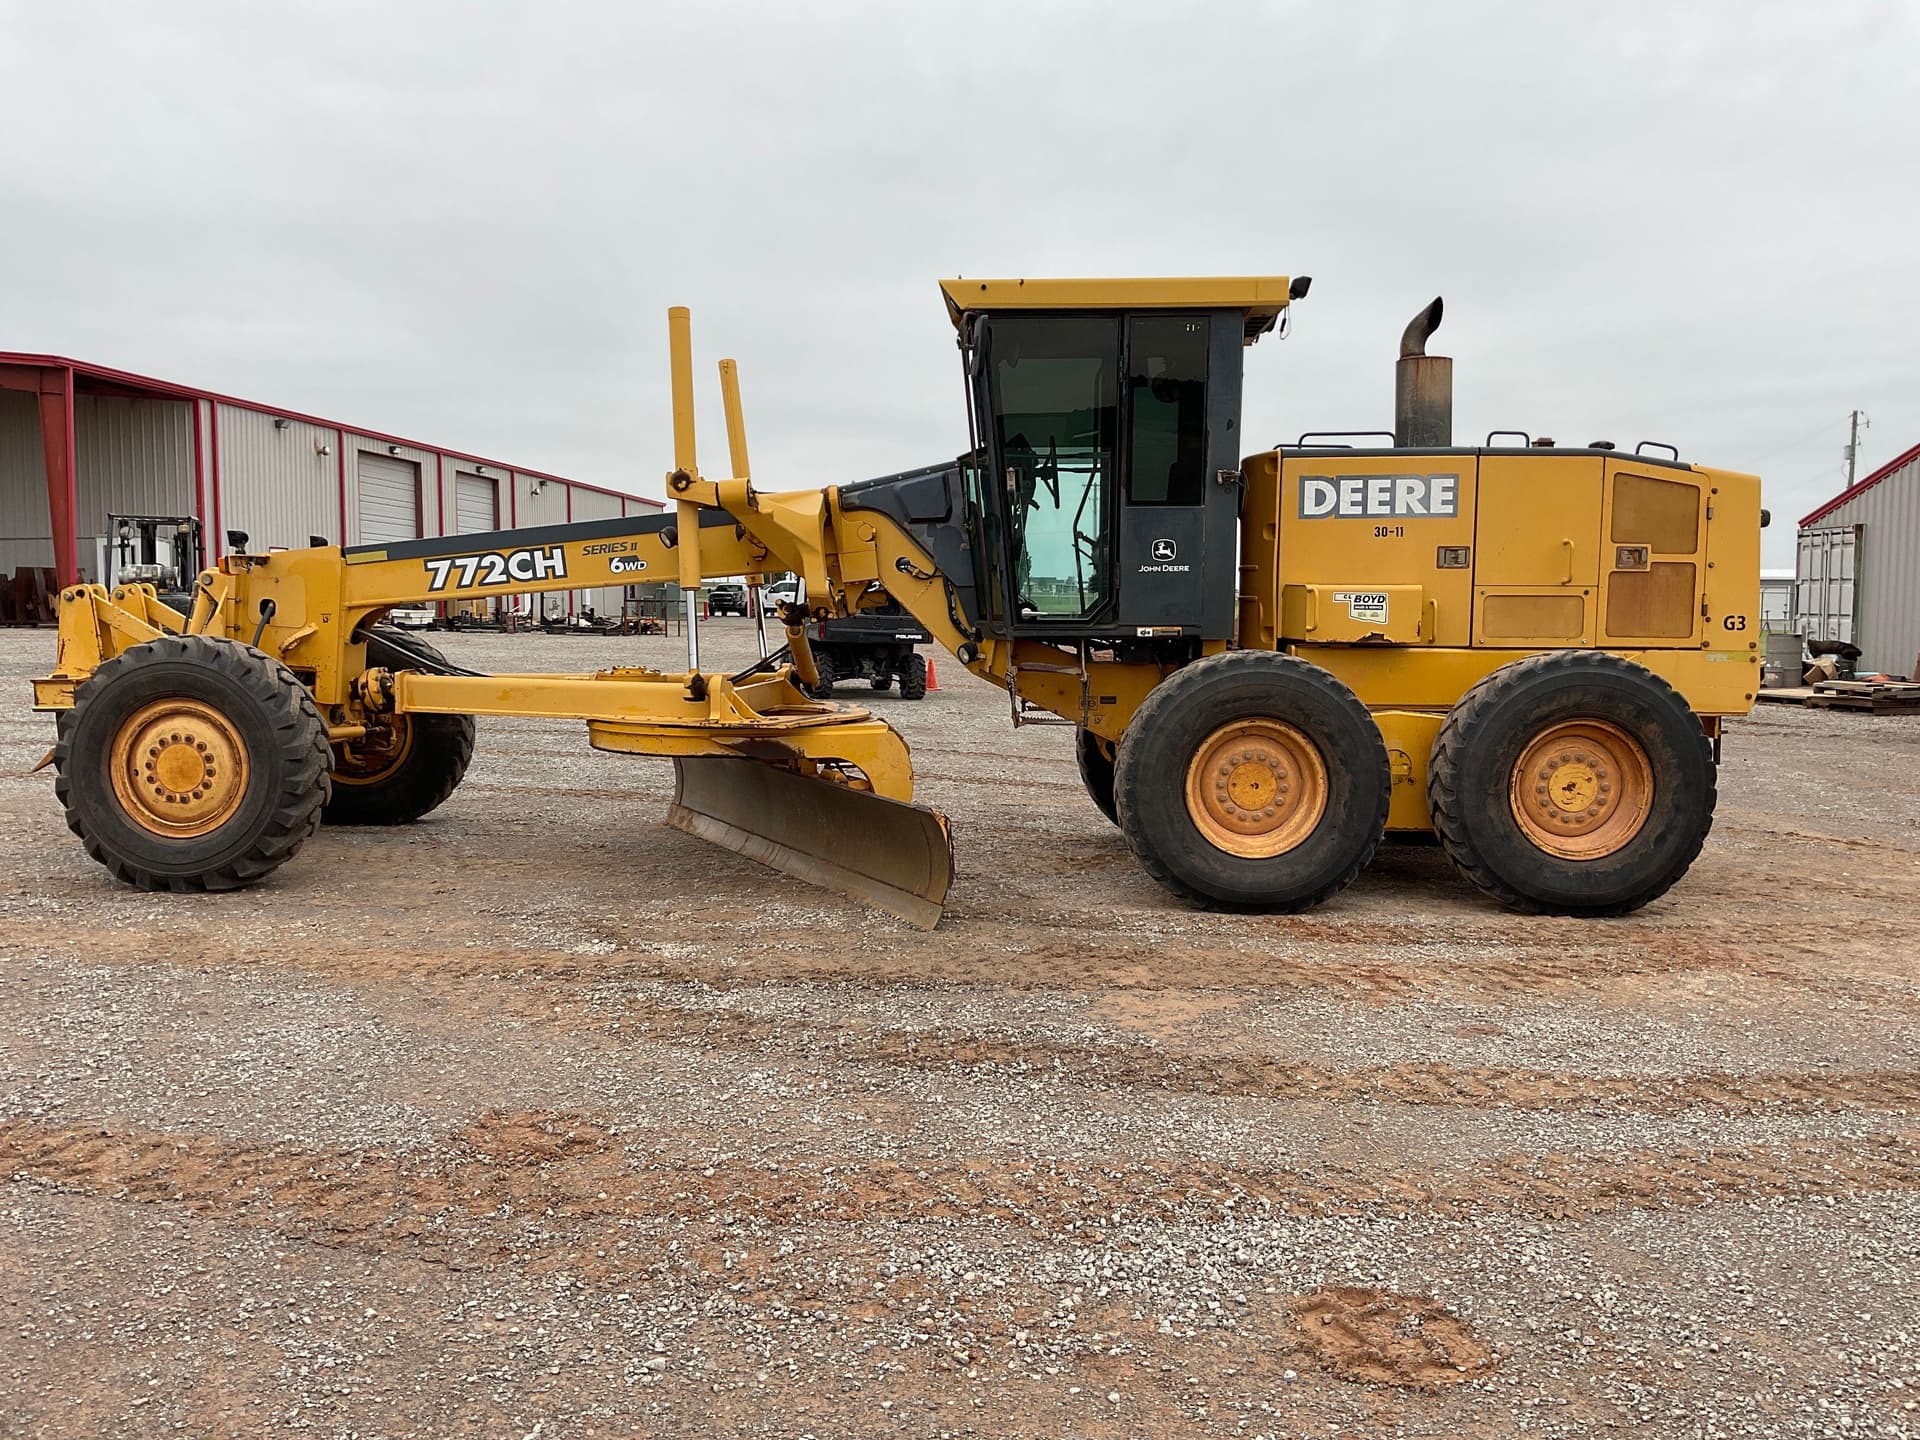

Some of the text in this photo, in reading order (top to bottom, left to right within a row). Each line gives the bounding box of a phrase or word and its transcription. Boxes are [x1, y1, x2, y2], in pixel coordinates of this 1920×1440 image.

[1302, 478, 1455, 515] DEERE
[1374, 526, 1404, 537] 30-11
[582, 542, 628, 556] SERIES
[425, 546, 567, 591] 772CH
[609, 556, 648, 574] 6WD
[1354, 595, 1386, 604] BOYD
[1723, 615, 1746, 631] G3
